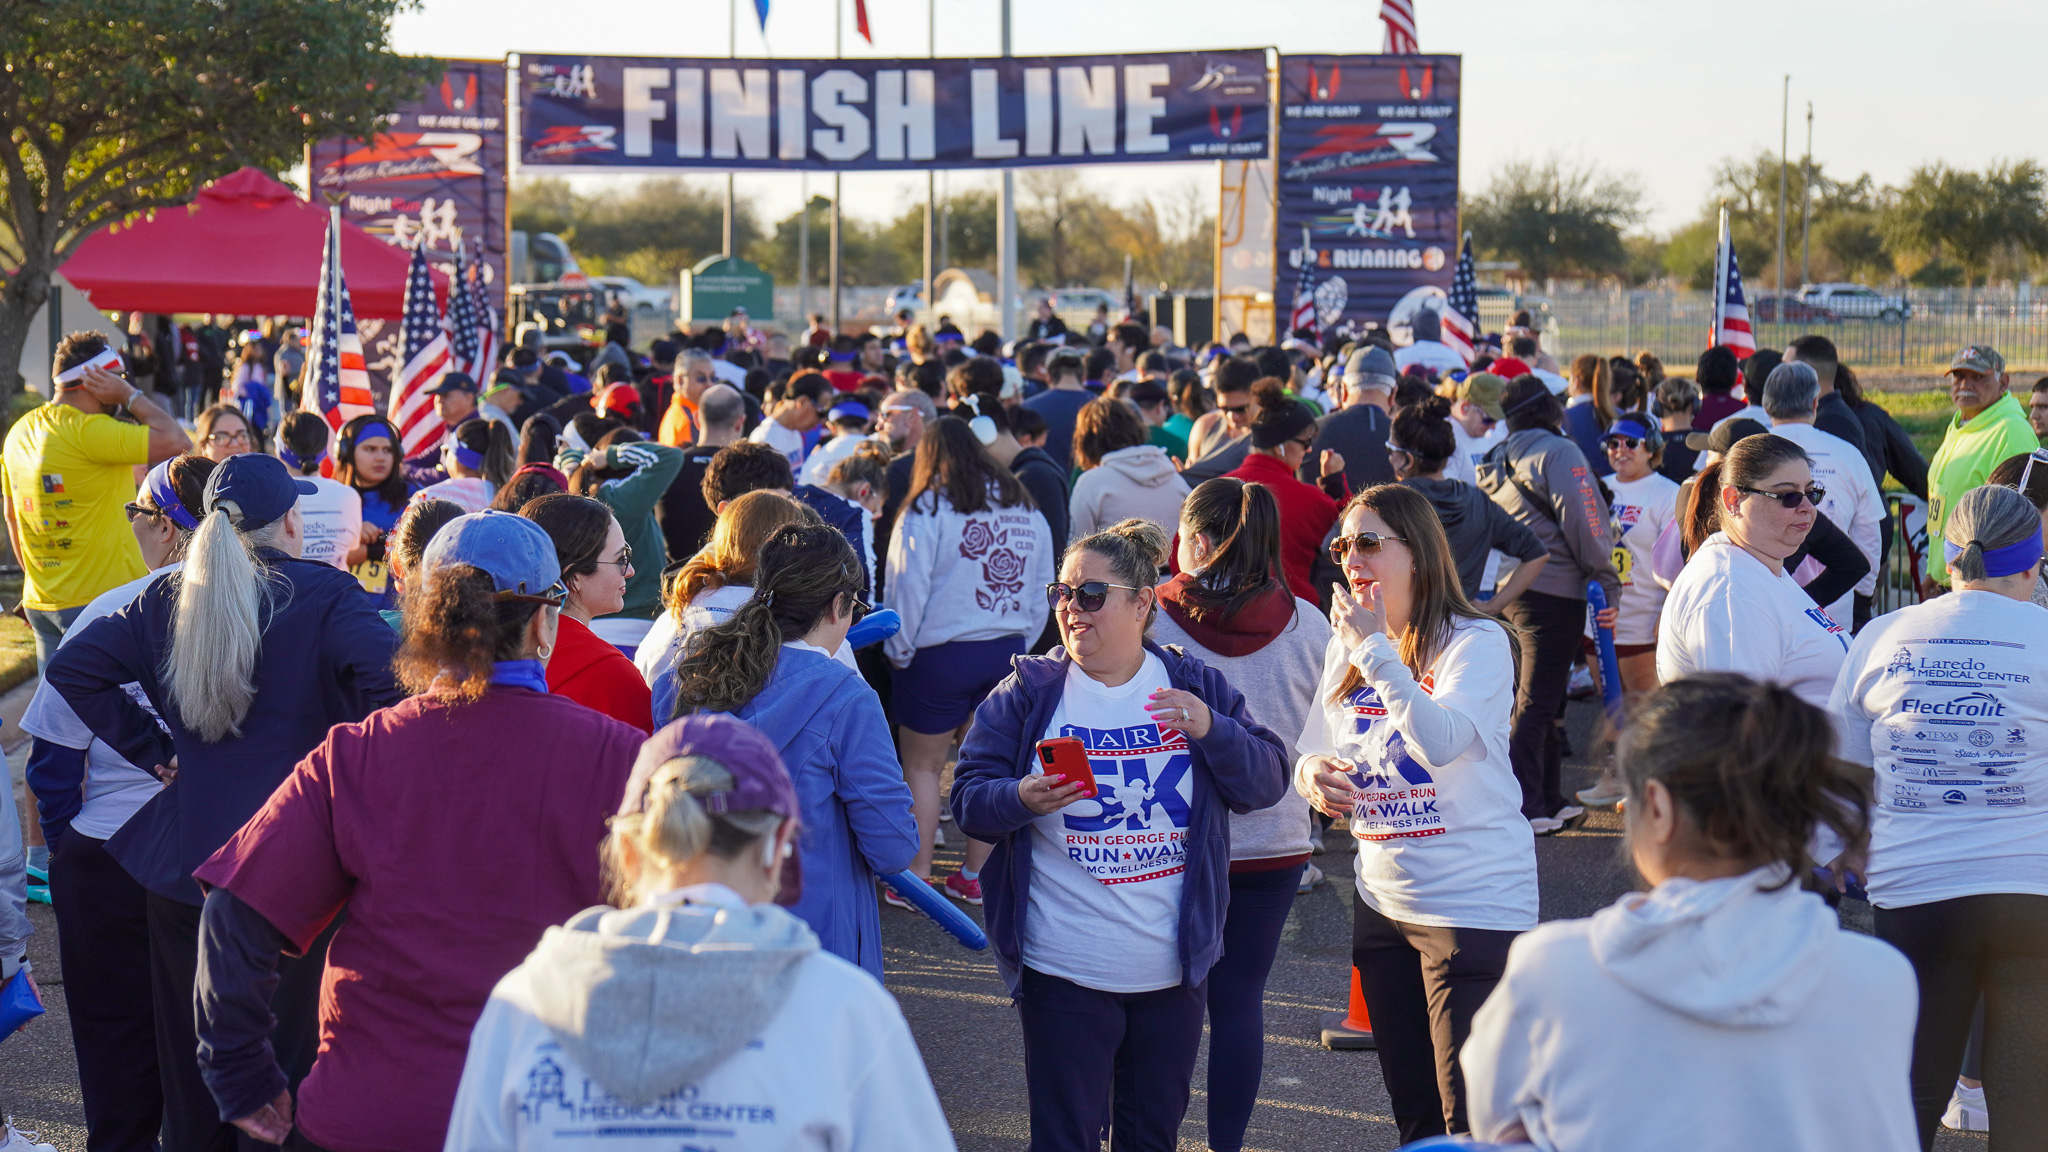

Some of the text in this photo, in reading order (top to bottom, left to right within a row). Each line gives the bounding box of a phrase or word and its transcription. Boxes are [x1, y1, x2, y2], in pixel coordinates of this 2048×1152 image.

[623, 64, 1170, 162] FINISH LINE
[1286, 106, 1302, 117] WE
[1304, 106, 1325, 118] ARE
[1378, 106, 1394, 117] WE
[1395, 106, 1417, 118] ARE
[418, 115, 437, 127] WE
[438, 115, 461, 128] ARE
[1333, 248, 1423, 269] RUNNING
[1000, 515, 1030, 524] BROKEN
[303, 545, 336, 553] trolit
[1015, 542, 1034, 551] CLUB
[1610, 552, 1624, 573] 3
[1919, 657, 1985, 670] Laredo
[1918, 670, 2030, 684] MEDICAL CENTER
[1901, 699, 2006, 717] Electrolit
[1927, 731, 1959, 739] TEXAS
[1063, 754, 1191, 832] 5K
[1367, 790, 1406, 802] GEORGE
[1411, 788, 1436, 798] RUN
[1377, 800, 1439, 818] WALK
[1361, 815, 1441, 830] WELLNESS FAIR
[1066, 831, 1190, 845] RUN GEORGE RU
[1068, 847, 1119, 863] RUN
[1081, 866, 1106, 874] MC
[1109, 858, 1168, 874] WELLNESS
[687, 1104, 776, 1123] CENTER
